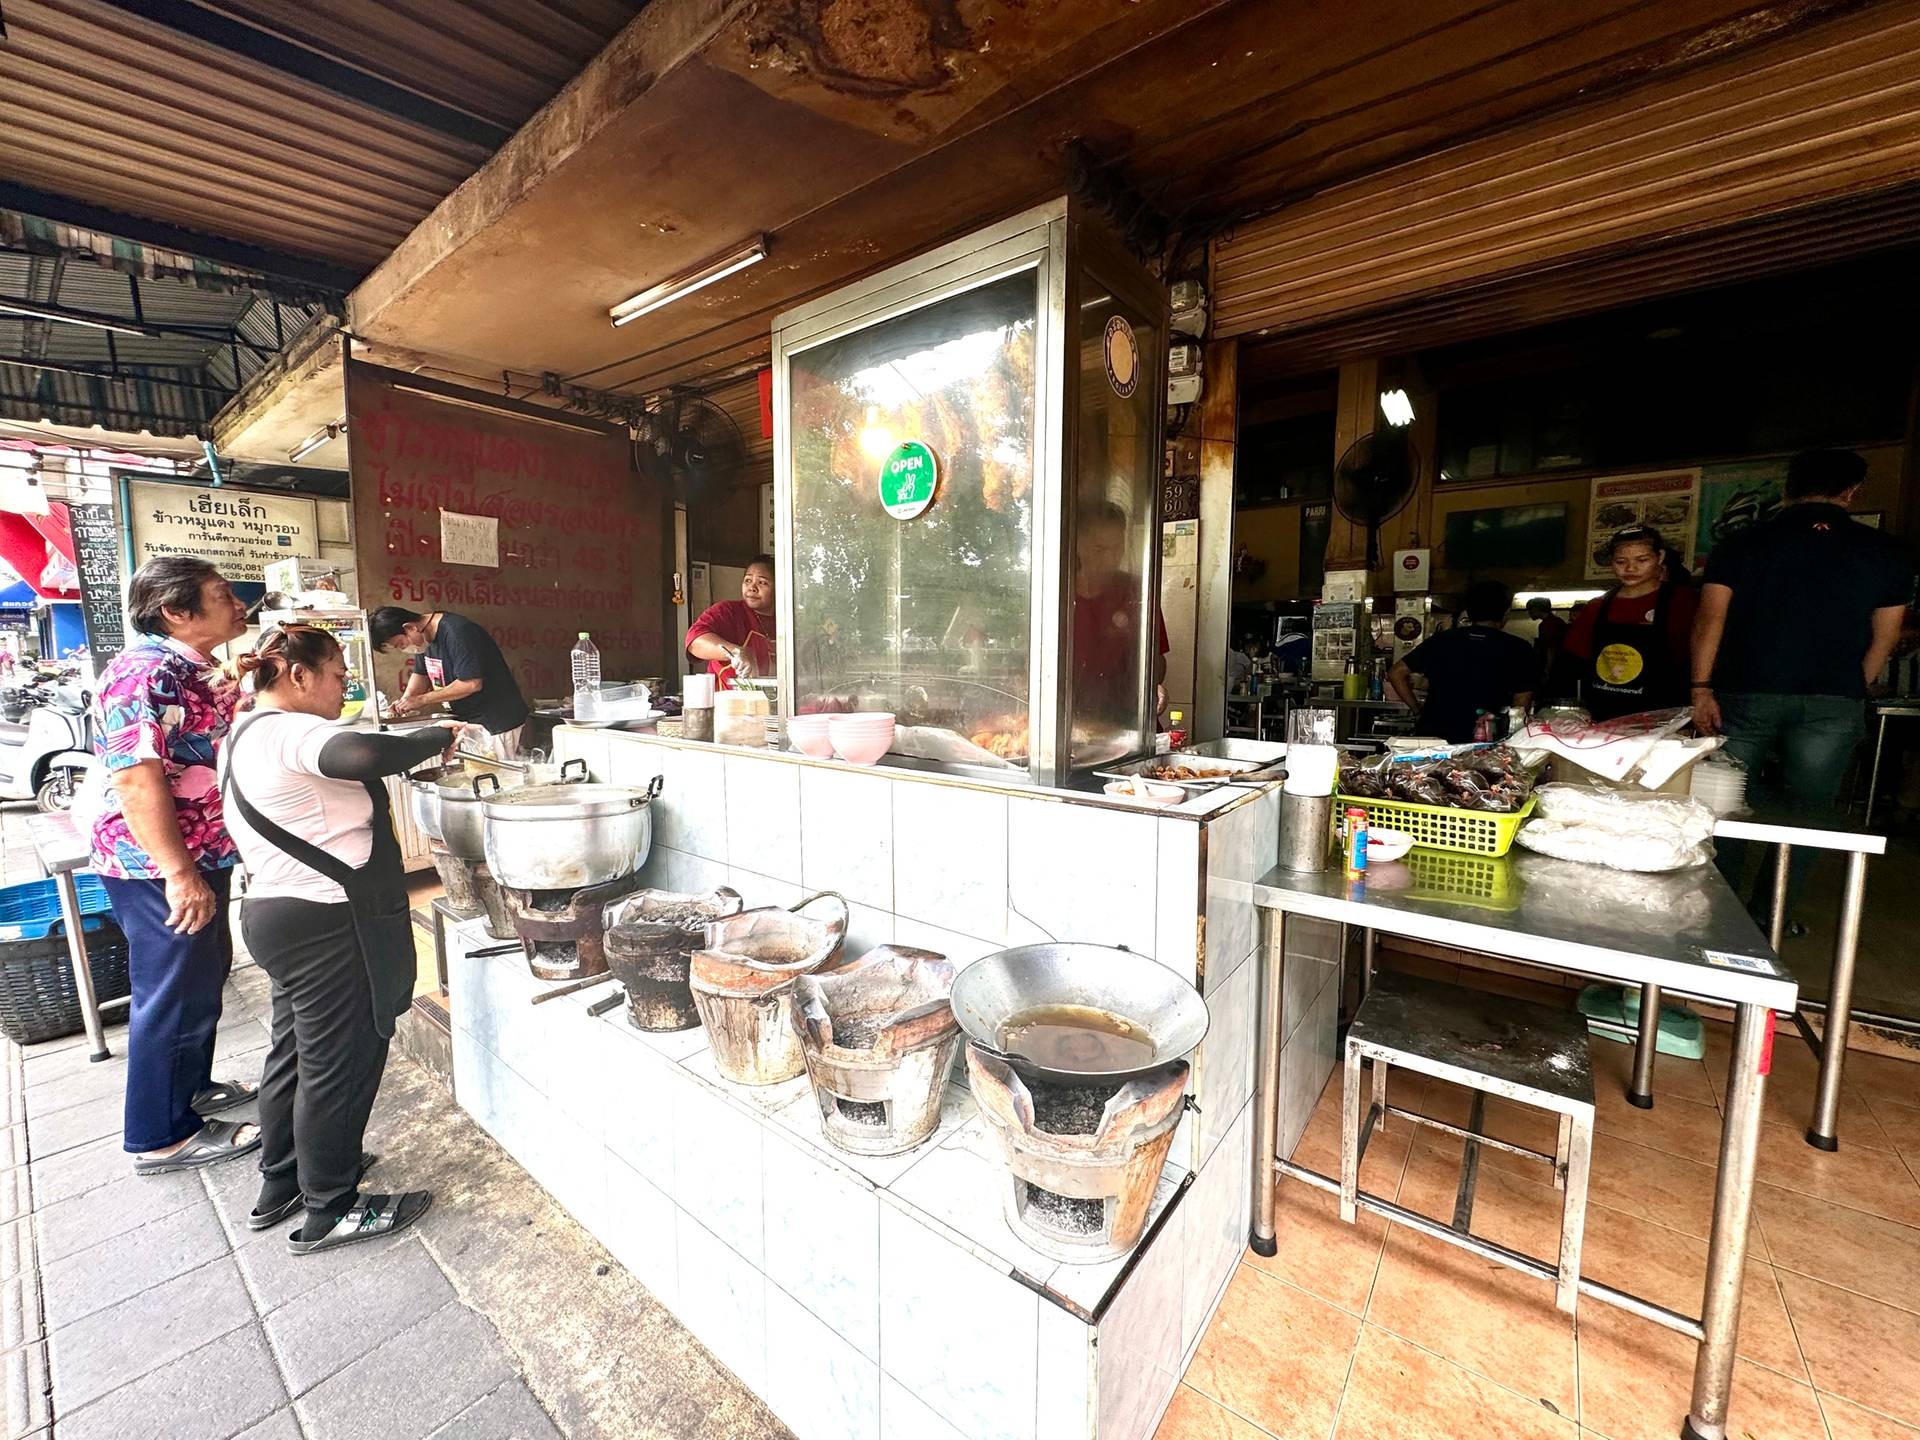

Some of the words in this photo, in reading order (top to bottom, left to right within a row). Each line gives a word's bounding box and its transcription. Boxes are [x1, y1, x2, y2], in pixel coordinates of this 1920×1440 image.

[891, 456, 923, 474] OPEN
[1165, 485, 1183, 499] 59
[188, 493, 267, 520] เฮียเล็ก
[1164, 499, 1182, 513] 60
[152, 509, 235, 531] ข้าวหมูแดง
[242, 518, 301, 536] หมูกรอบ
[143, 543, 245, 558] รับจัดงานนอกสถานที่
